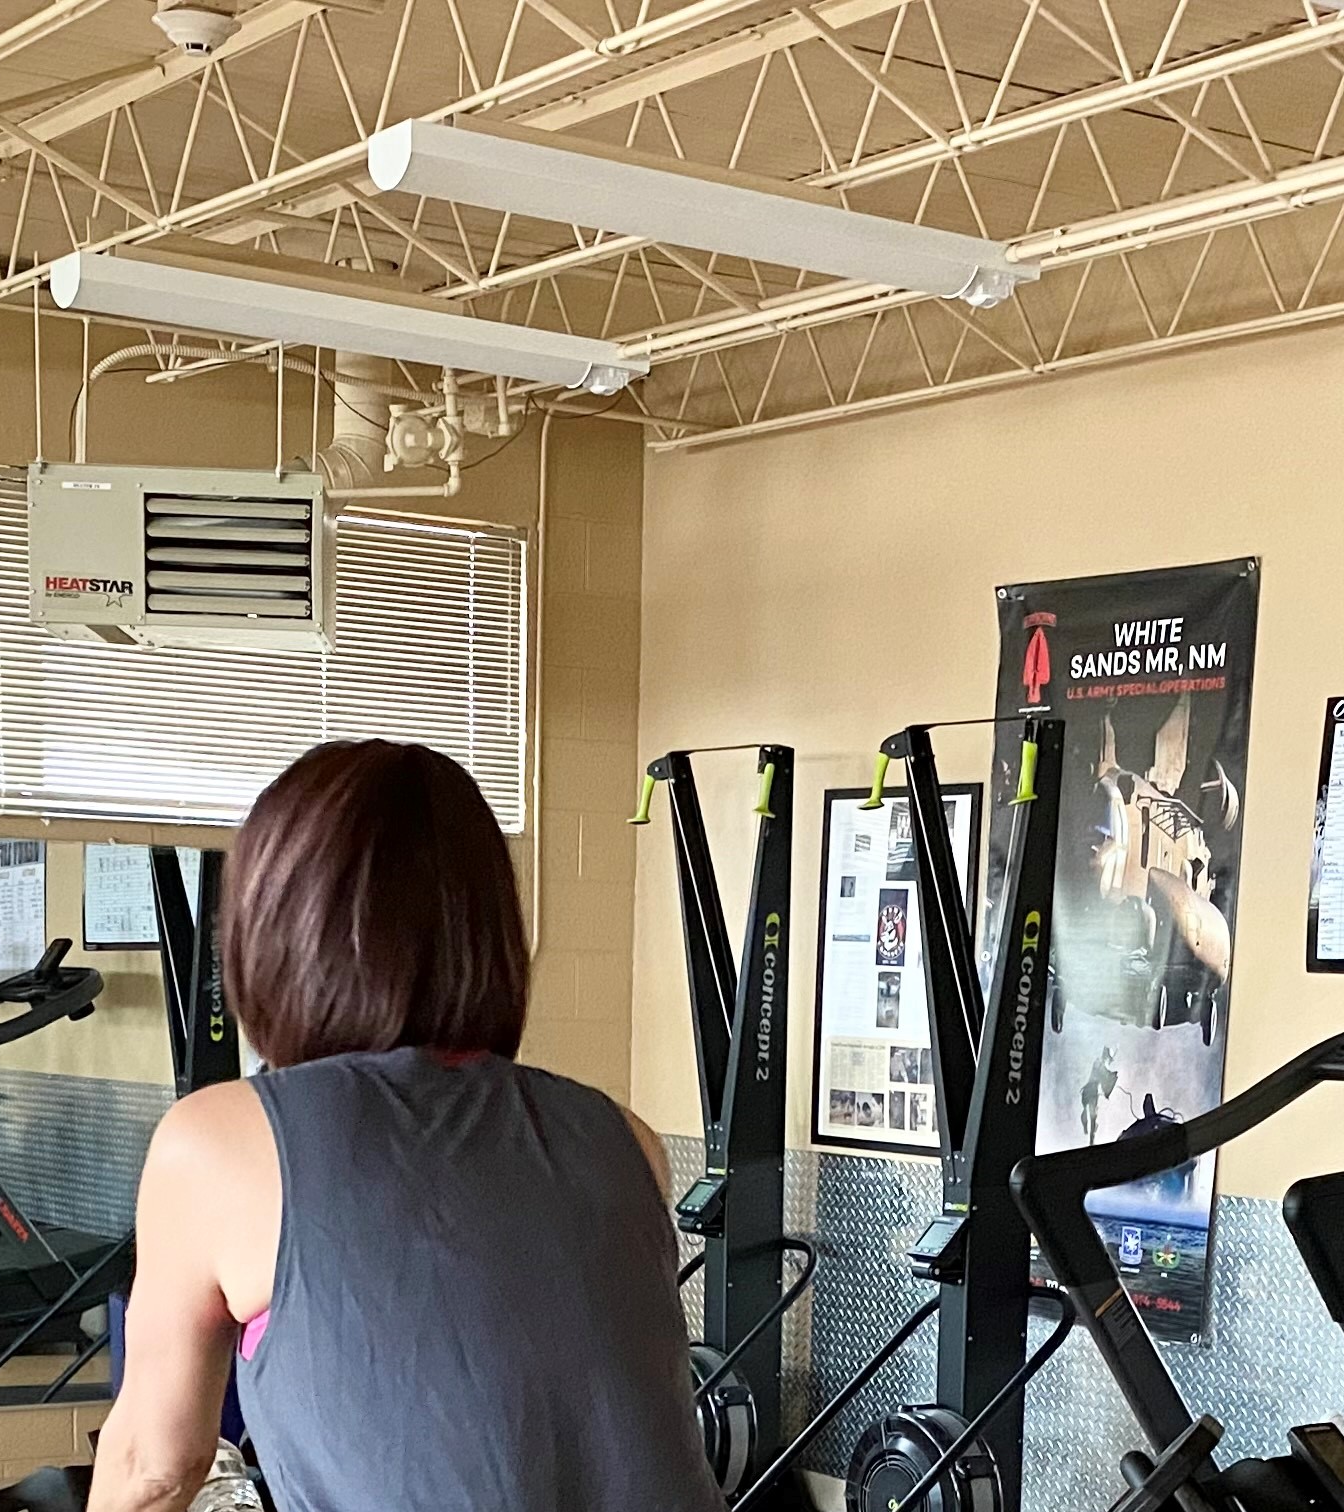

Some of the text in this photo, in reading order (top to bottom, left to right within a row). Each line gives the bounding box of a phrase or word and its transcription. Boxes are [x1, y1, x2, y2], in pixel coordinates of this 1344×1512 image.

[45, 576, 133, 594] HEATSTAR
[1114, 618, 1183, 647] WHITE
[1070, 643, 1226, 679] SANDS MR, NM
[1087, 683, 1113, 698] ARMY
[1116, 680, 1158, 697] SPECIAL
[1160, 677, 1225, 693] OPERATIONS
[757, 951, 777, 1065] concept
[1006, 955, 1035, 1105] concept 2
